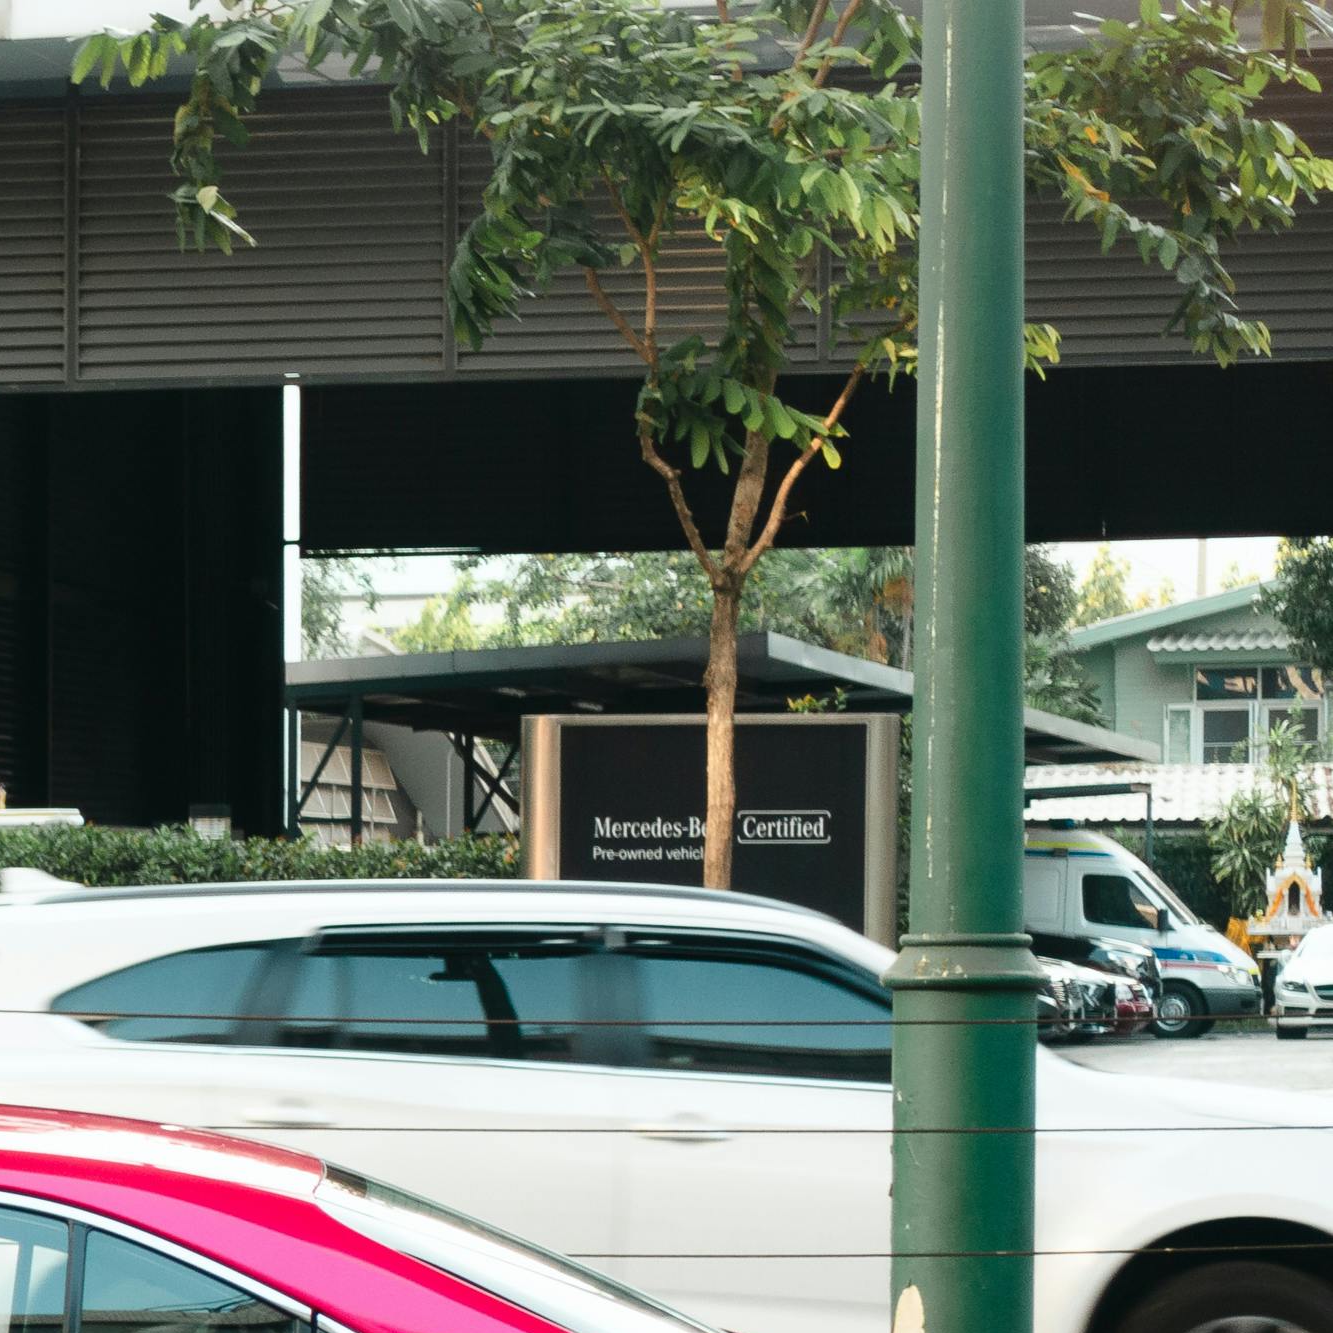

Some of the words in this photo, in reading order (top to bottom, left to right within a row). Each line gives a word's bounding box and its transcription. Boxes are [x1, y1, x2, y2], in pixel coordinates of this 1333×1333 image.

[594, 816, 708, 839] Mercedes-Be
[743, 816, 824, 838] Certified
[592, 845, 662, 860] Pre-owned
[666, 845, 704, 860] vehicl
